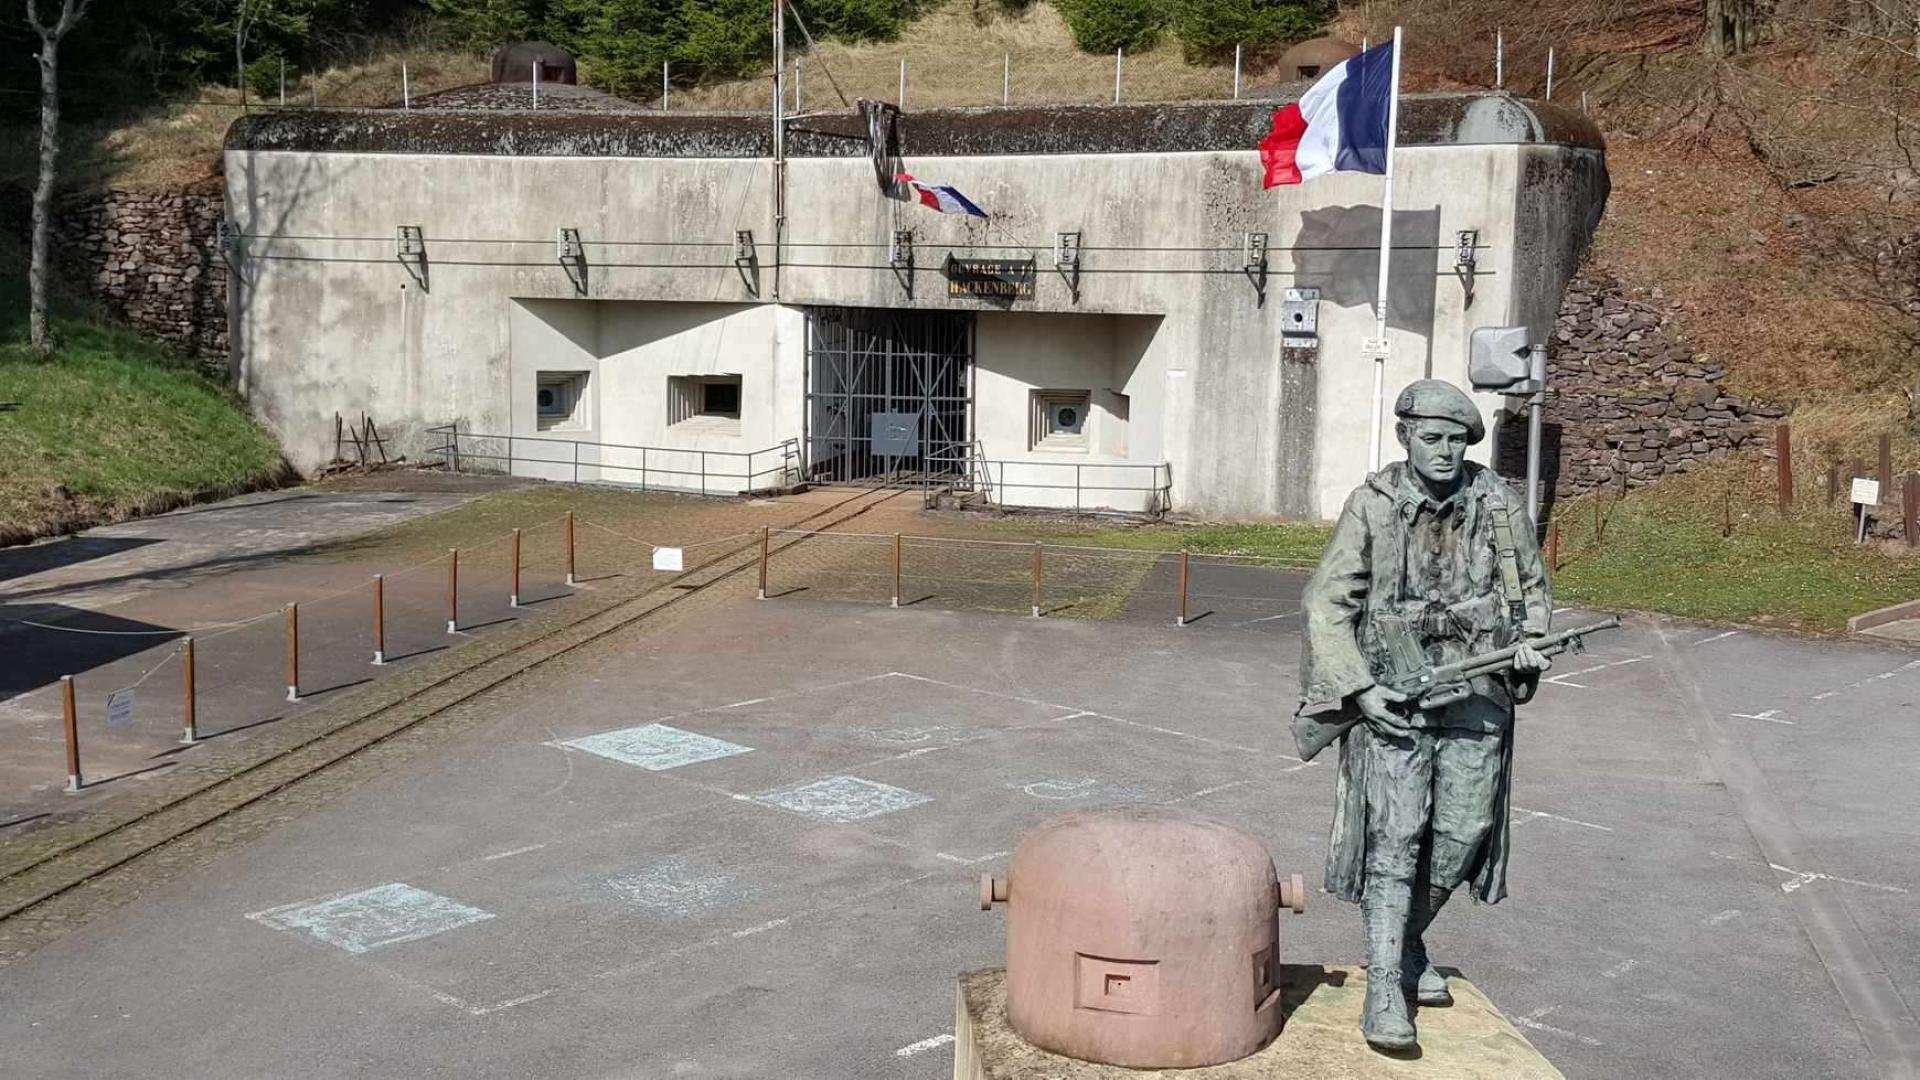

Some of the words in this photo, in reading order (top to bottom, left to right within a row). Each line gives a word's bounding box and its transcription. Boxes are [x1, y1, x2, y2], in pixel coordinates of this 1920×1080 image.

[951, 264, 1001, 275] OUVRAGE
[1008, 265, 1015, 275] A
[950, 280, 1032, 295] HACKENBERG
